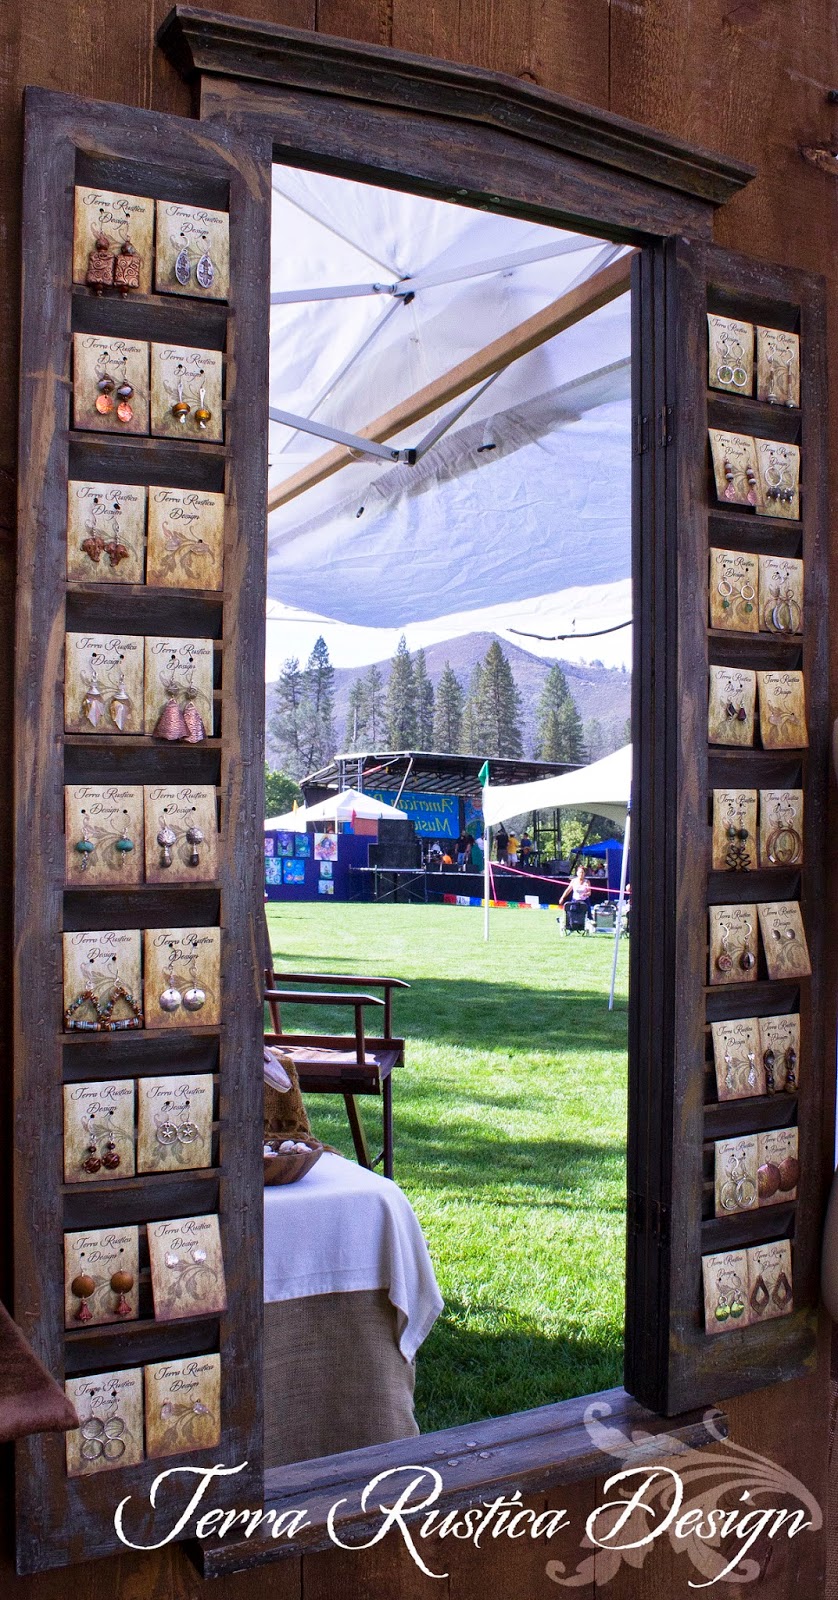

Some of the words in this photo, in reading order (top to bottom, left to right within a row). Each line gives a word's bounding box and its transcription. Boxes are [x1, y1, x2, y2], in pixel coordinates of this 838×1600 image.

[83, 194, 110, 207] Terra
[112, 200, 146, 215] Rustica
[100, 212, 129, 230] Design
[166, 206, 191, 218] Terra
[193, 211, 223, 226] Rustica
[181, 223, 209, 239] Design
[82, 338, 107, 348] Terra
[110, 342, 141, 356] Rustica
[98, 354, 126, 369] Design
[160, 350, 184, 361] Terra
[186, 354, 216, 369] Rustica
[77, 487, 102, 498] Terra
[105, 490, 138, 504] Rustica
[154, 491, 180, 503] Terra
[183, 495, 215, 510] Rustica
[92, 504, 122, 520] Design
[170, 508, 200, 525] Design
[76, 638, 102, 649] Terra
[105, 639, 137, 655] Rustica
[152, 643, 177, 654] Terra
[179, 644, 210, 658] Rustica
[91, 654, 122, 671] Design
[167, 659, 195, 675] Design
[74, 788, 100, 799] Terra
[102, 788, 134, 802] Rustica
[150, 789, 174, 799] Terra
[177, 789, 207, 803] Rustica
[90, 803, 119, 819] Design
[72, 933, 97, 945] Terra
[100, 932, 132, 947] Rustica
[153, 935, 179, 946] Terra
[182, 934, 214, 946] Rustica
[87, 948, 117, 964] Design
[169, 950, 198, 966] Design
[71, 1088, 97, 1100] Terra
[100, 1086, 132, 1101] Rustica
[147, 1086, 172, 1098] Terra
[174, 1085, 205, 1099] Rustica
[87, 1102, 117, 1117] Design
[161, 1101, 190, 1116] Design
[154, 1225, 178, 1237] Terra
[181, 1221, 211, 1234] Rustica
[72, 1238, 97, 1249] Terra
[100, 1235, 132, 1249] Rustica
[171, 1238, 198, 1252] Design
[88, 1251, 117, 1265] Design
[154, 1366, 180, 1380] Terra
[182, 1362, 214, 1377] Rustica
[74, 1383, 101, 1396] Terra
[103, 1379, 135, 1392] Rustica
[170, 1380, 199, 1393] Design
[91, 1396, 119, 1410] Design
